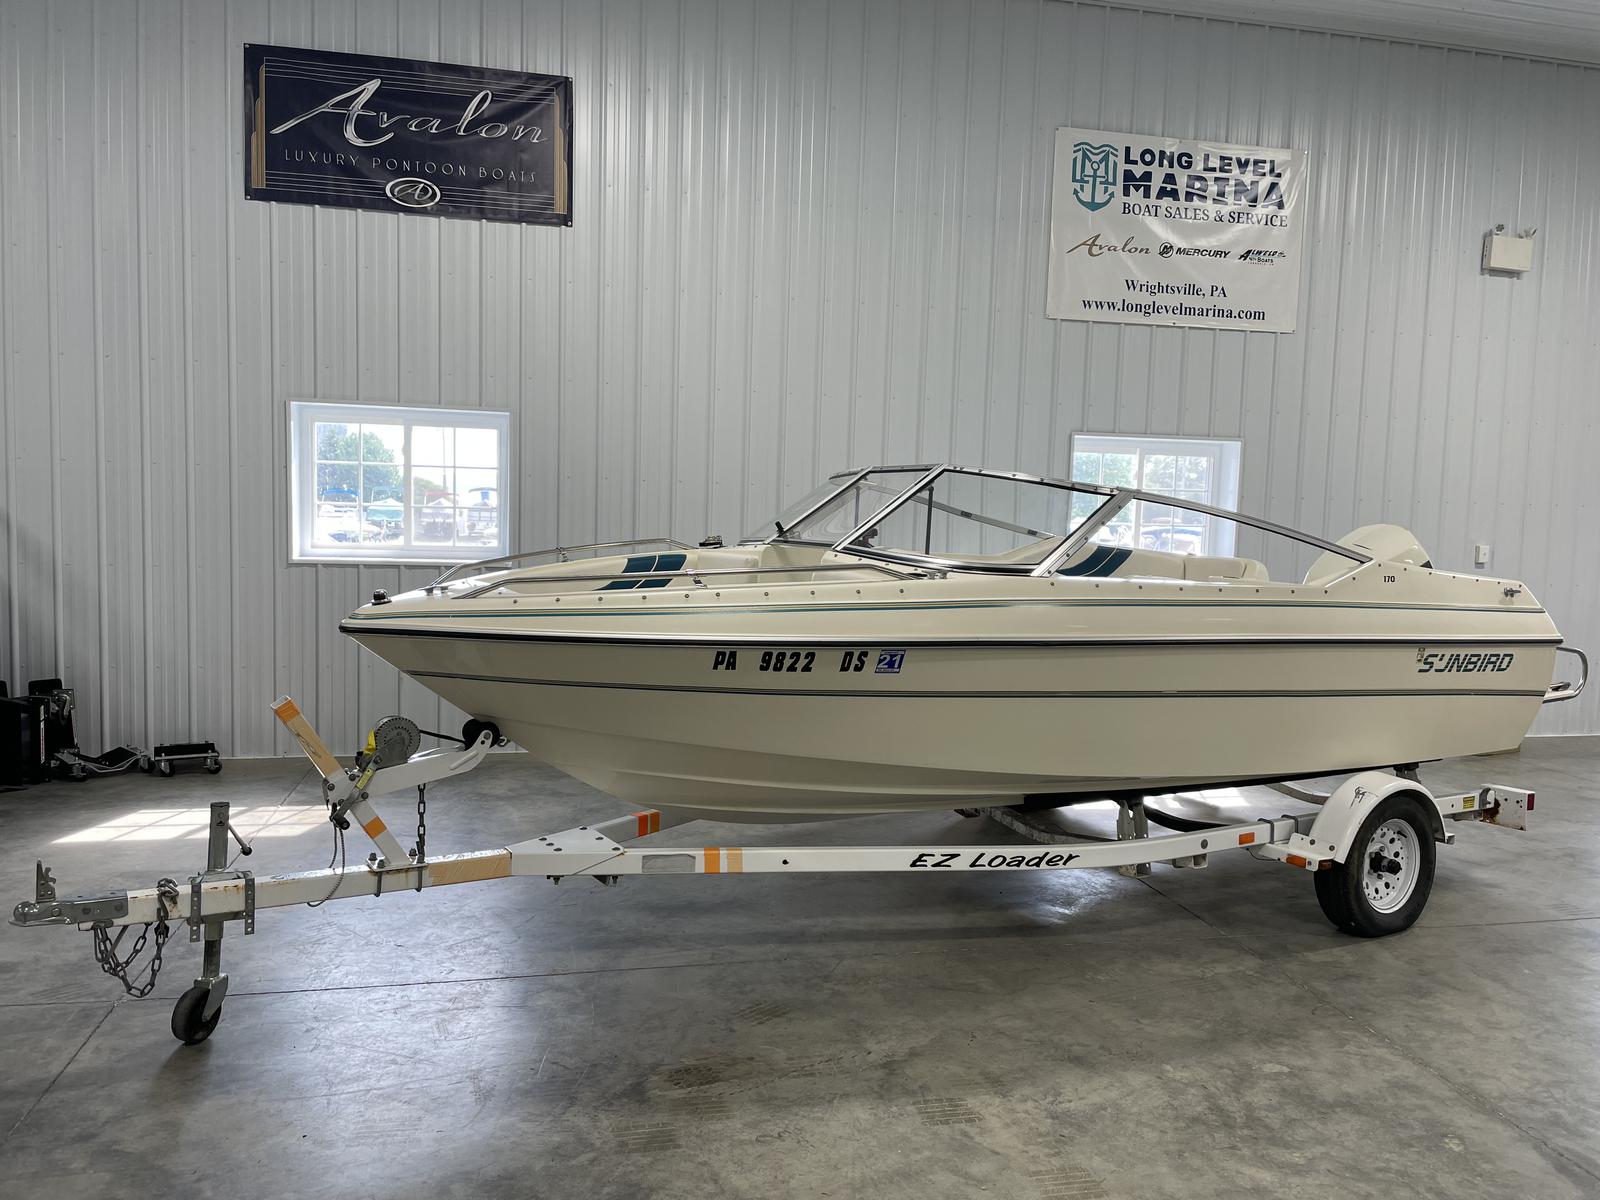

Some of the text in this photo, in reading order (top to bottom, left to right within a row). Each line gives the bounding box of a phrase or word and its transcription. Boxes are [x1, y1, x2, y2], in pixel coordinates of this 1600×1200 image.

[269, 78, 548, 147] Avalon
[285, 149, 536, 183] LUXURY PONTOON BOATS
[1124, 146, 1281, 178] LONG LEVEL
[1123, 169, 1284, 210] MARINA
[1121, 202, 1288, 227] BOAT SALES & SERVICE
[1066, 233, 1151, 257] Avalon
[1175, 247, 1231, 259] MERCURY
[1125, 279, 1228, 299] Wrightsville, PA
[1082, 299, 1266, 321] www.longlevelmarina.com
[1383, 575, 1396, 583] 170
[712, 650, 868, 672] PA 9822 DS
[877, 654, 902, 668] 21
[1417, 653, 1514, 673] SUNBIRD
[909, 851, 1081, 869] EZ Loader
